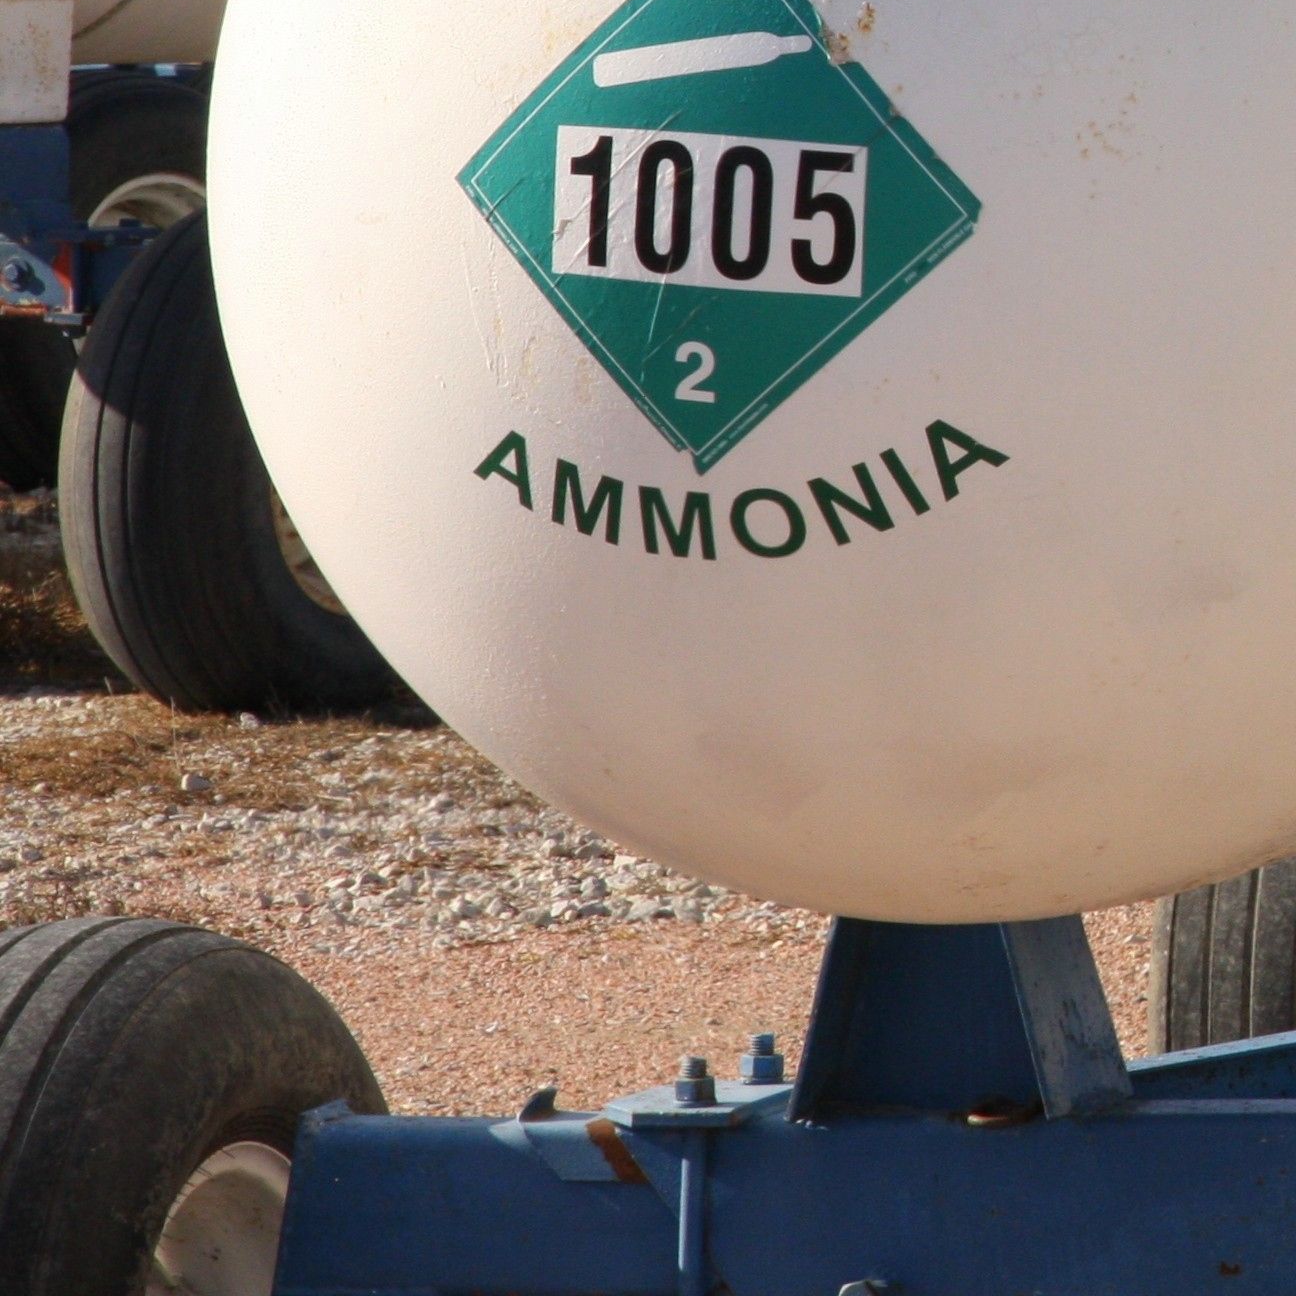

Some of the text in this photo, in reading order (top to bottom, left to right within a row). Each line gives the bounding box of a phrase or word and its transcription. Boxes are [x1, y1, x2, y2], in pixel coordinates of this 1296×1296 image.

[568, 135, 858, 286] 1005
[674, 341, 717, 404] 2
[472, 418, 1011, 562] AMMONIA
